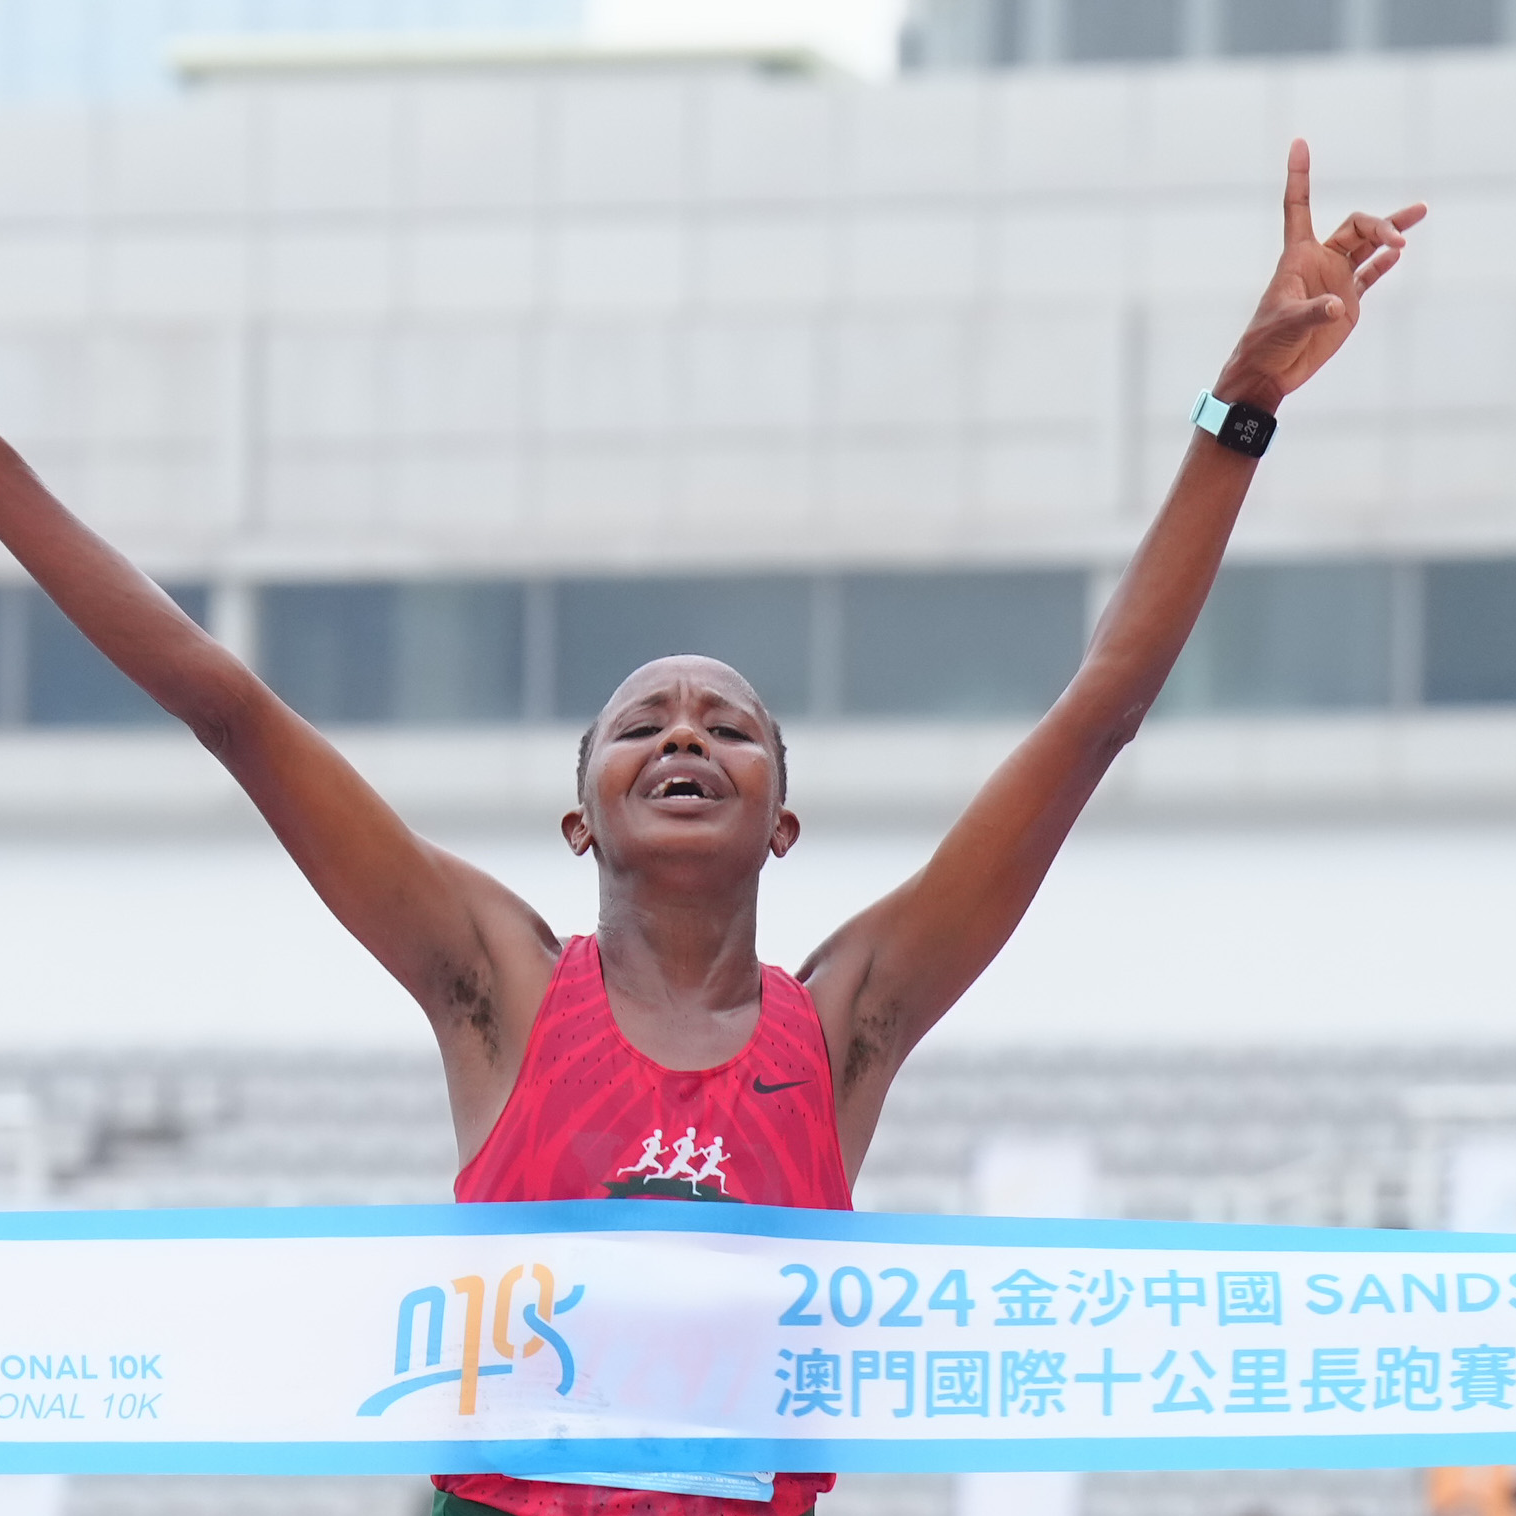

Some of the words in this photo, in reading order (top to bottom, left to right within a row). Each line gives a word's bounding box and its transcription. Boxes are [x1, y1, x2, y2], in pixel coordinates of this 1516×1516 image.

[776, 1262, 976, 1328] 2024
[992, 1268, 1284, 1328] 金沙中國
[109, 1354, 164, 1381] 10K
[103, 1392, 163, 1420] 10K
